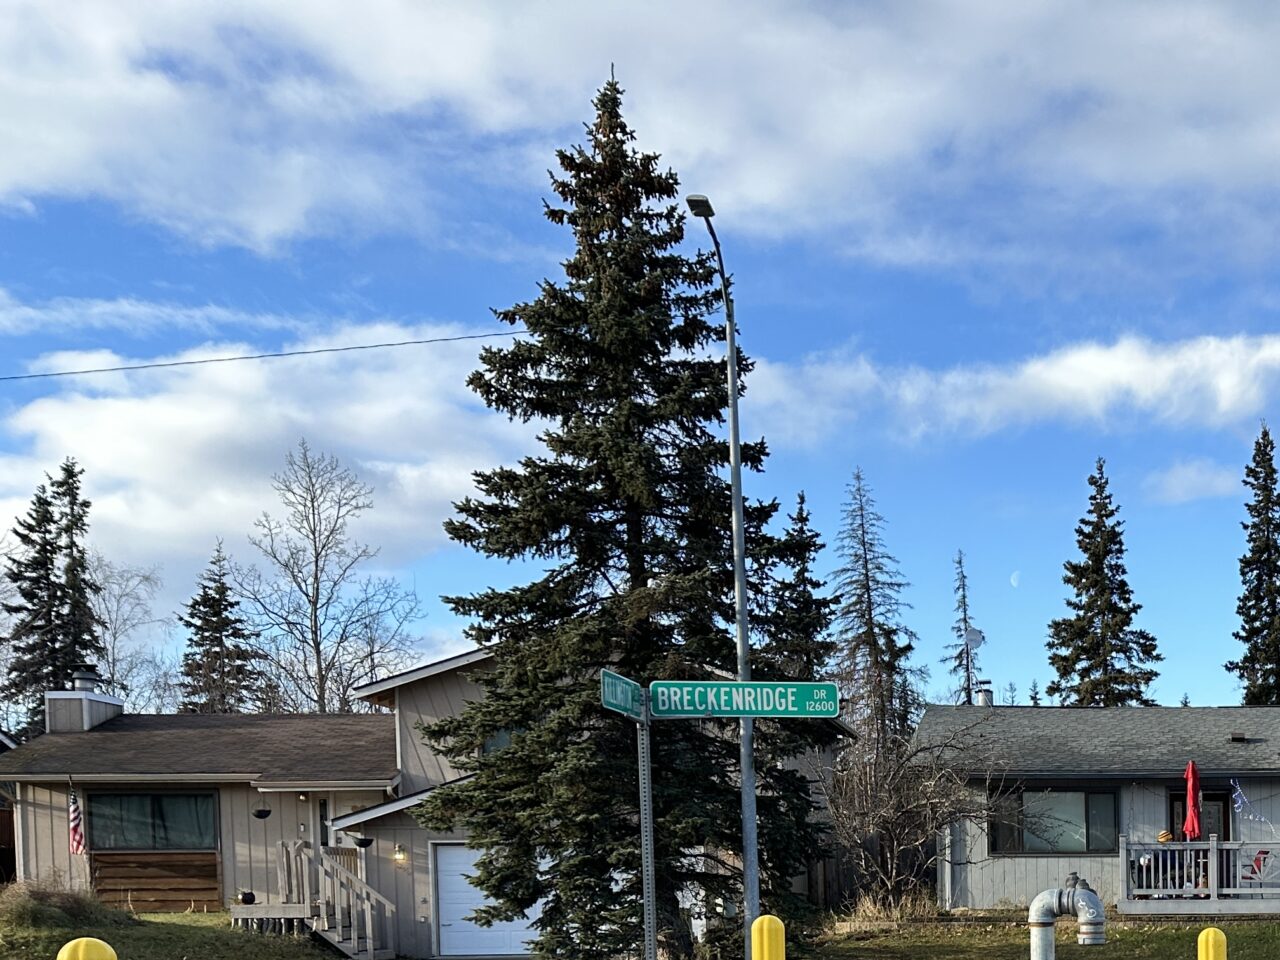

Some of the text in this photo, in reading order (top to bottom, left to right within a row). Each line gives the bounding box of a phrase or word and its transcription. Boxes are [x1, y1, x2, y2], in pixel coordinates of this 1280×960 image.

[657, 686, 799, 711] BRECKENRIDGE
[813, 689, 827, 699] DR
[805, 701, 835, 712] 12600
